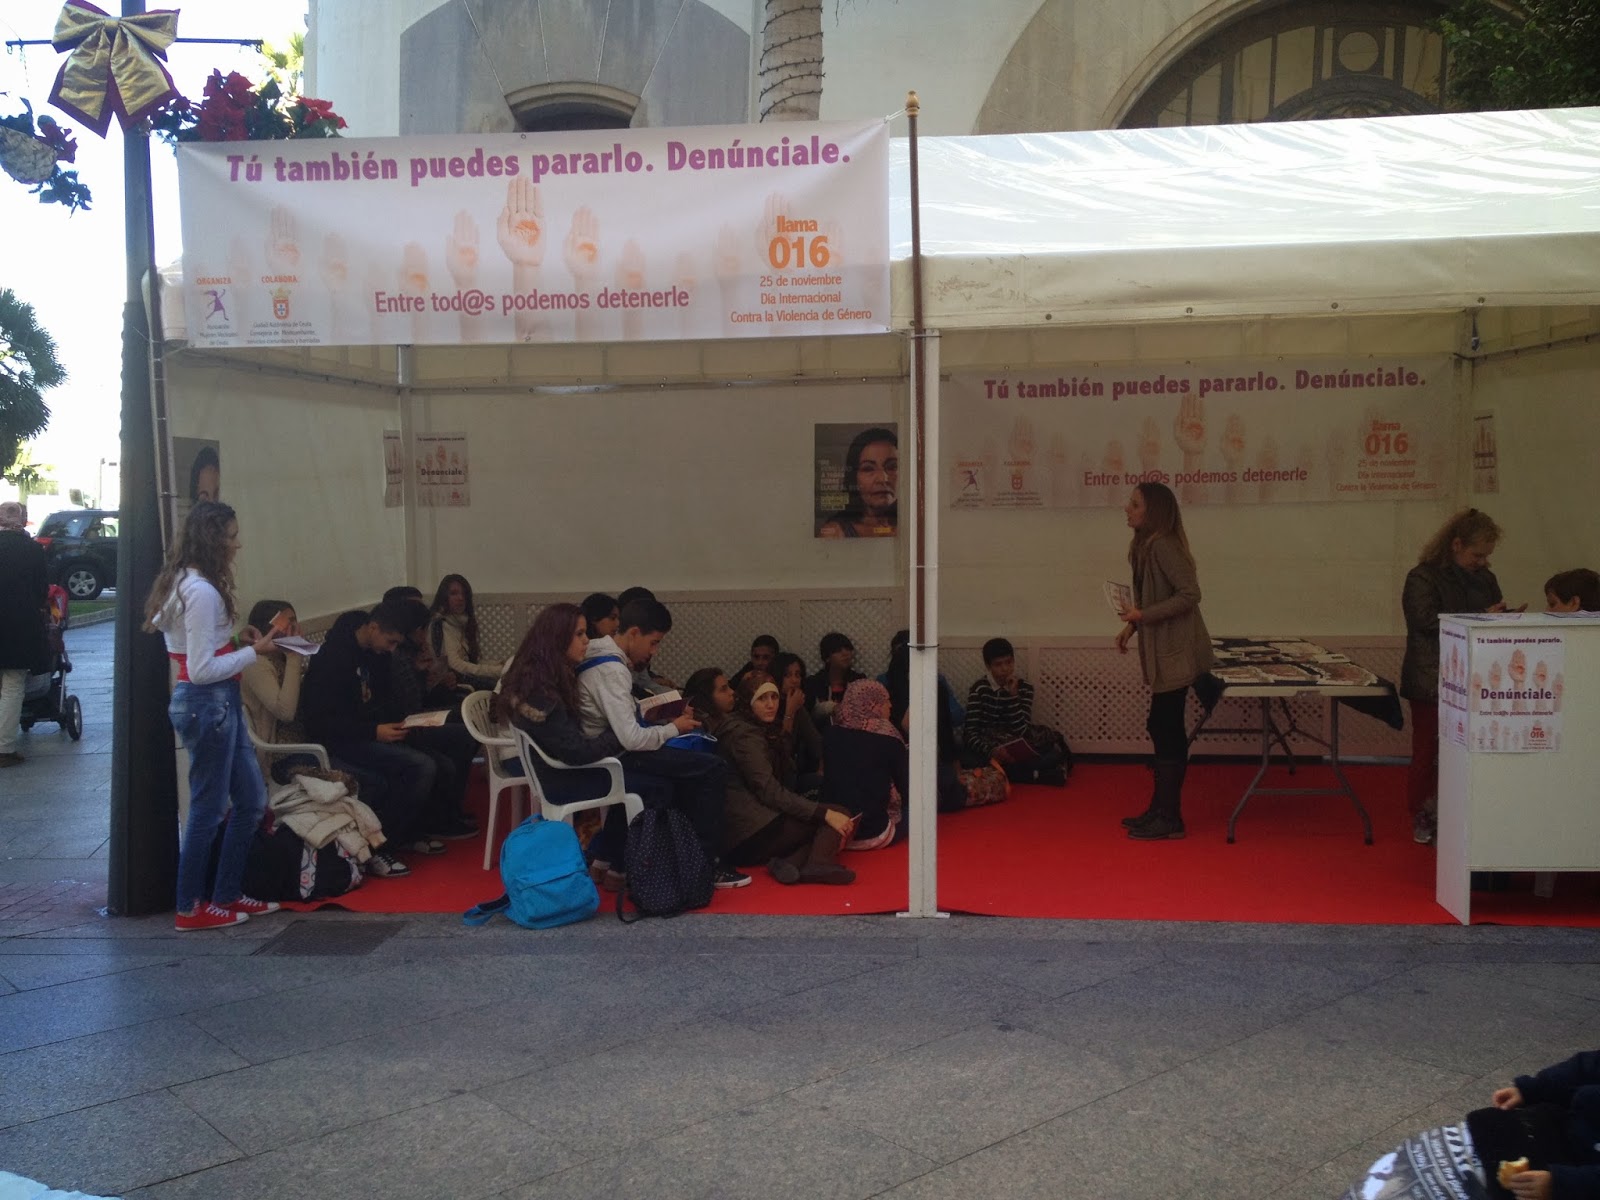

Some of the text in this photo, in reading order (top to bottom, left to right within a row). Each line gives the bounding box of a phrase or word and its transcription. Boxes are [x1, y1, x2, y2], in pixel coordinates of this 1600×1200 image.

[227, 135, 852, 187] Tú también puedes pararlo. Denúnciale.
[777, 216, 818, 232] llama
[769, 236, 830, 268] 016
[196, 276, 232, 285] ORGANIZA
[262, 275, 298, 284] COLABORA
[760, 274, 842, 287] 25 de noviembre
[376, 286, 690, 316] Entre tod@s podemos detenerle
[761, 292, 841, 304] Día Internacional
[731, 308, 872, 323] Contra la Violencia de Género
[984, 367, 1426, 401] Tú también puedes pararlo. Denúnciale.
[1365, 433, 1408, 455] 016
[1085, 468, 1308, 486] Entre tod@s podemos detenerle
[1480, 688, 1556, 700] Denúnciale.
